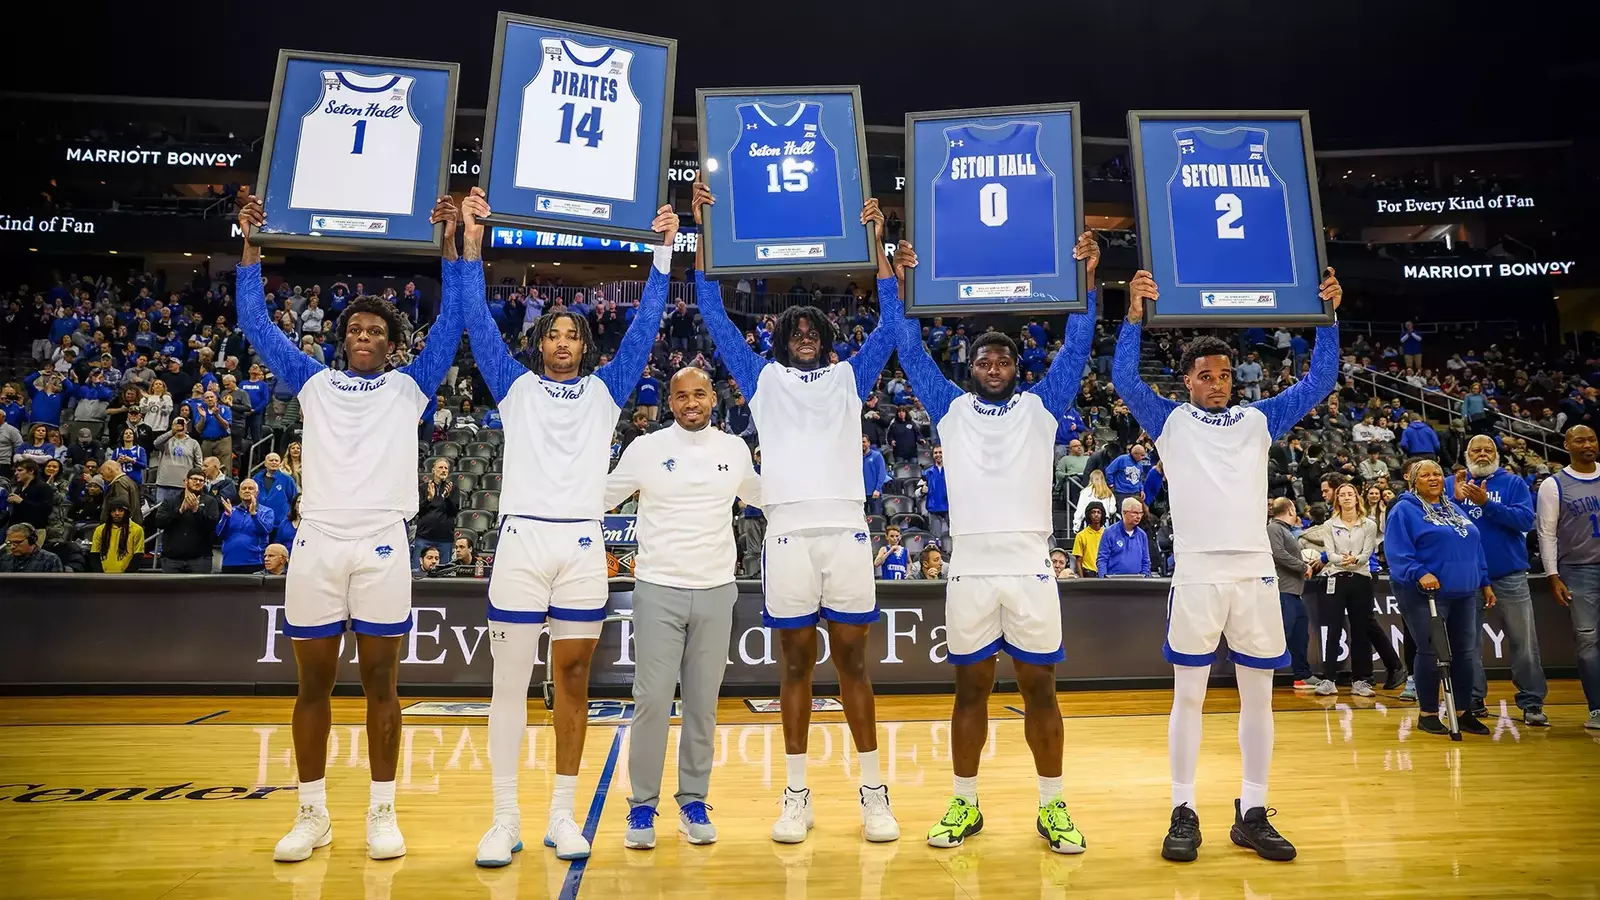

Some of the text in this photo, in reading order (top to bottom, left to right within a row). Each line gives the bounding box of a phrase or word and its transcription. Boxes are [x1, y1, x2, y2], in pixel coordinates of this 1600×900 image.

[551, 70, 618, 103] PIRATES
[325, 99, 403, 119] Seton Hall
[350, 119, 367, 154] 1
[555, 102, 604, 148] 14
[66, 148, 240, 167] MARRIOTT BONVOY
[749, 140, 816, 157] Seton Hall
[767, 157, 815, 193] 15
[951, 153, 1036, 180] SETON HALL
[1182, 164, 1270, 187] SETON HALL
[979, 183, 1008, 227] 0
[1215, 193, 1245, 239] 2
[1377, 195, 1535, 214] For Every Kind of Fan
[39, 216, 59, 232] of
[60, 216, 95, 233] Fan
[536, 231, 583, 247] THE HALL
[1404, 261, 1573, 279] MARRIOTT BONVOY
